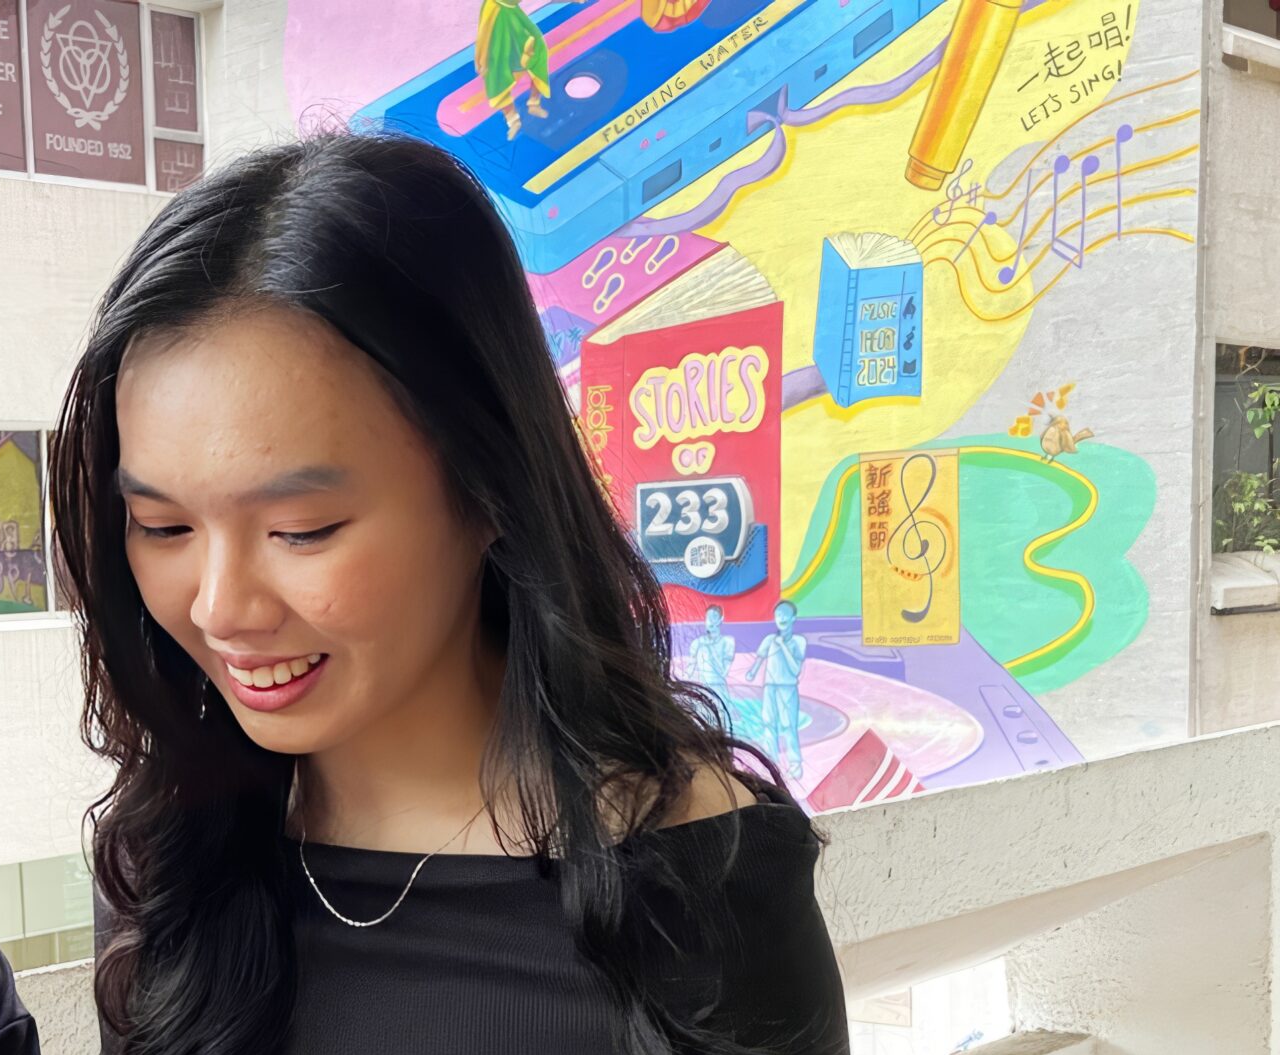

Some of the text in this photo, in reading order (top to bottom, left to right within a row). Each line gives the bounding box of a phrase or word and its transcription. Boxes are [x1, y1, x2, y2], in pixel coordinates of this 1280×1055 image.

[602, 16, 768, 142] FLOWING WATER
[1070, 60, 1122, 104] SING!
[45, 133, 132, 160] FOUNDED 1952
[857, 358, 896, 386] 2024
[634, 355, 761, 442] STORIES
[645, 488, 729, 536] 233
